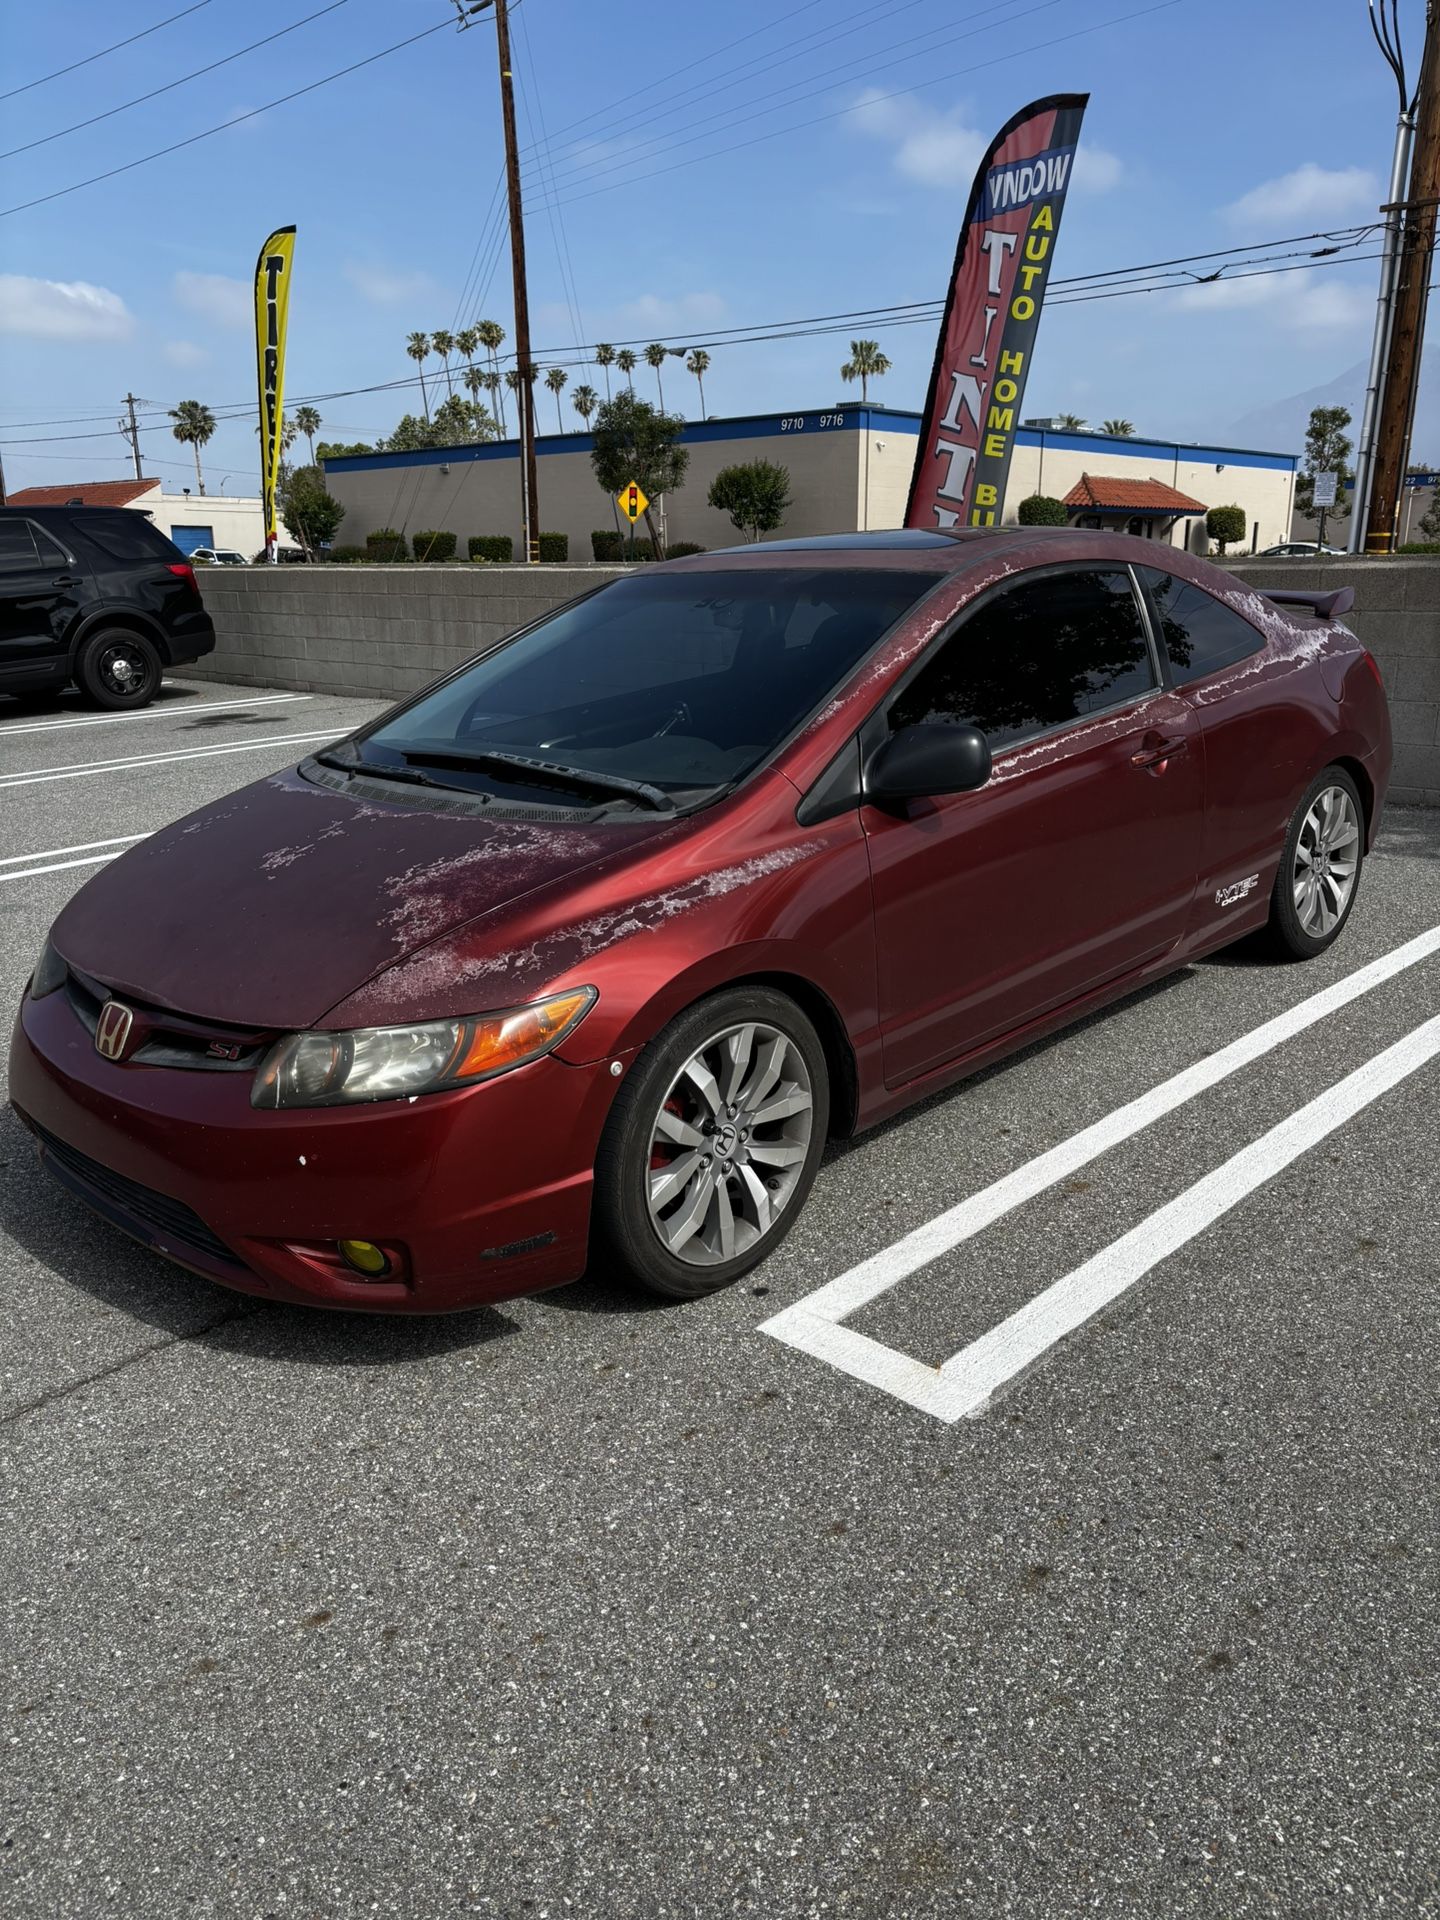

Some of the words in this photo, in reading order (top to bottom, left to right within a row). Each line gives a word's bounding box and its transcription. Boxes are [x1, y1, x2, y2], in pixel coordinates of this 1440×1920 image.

[1012, 205, 1053, 320] AUTO
[781, 417, 804, 431] 9710
[820, 414, 844, 428] 9716
[985, 350, 1024, 457] HOME
